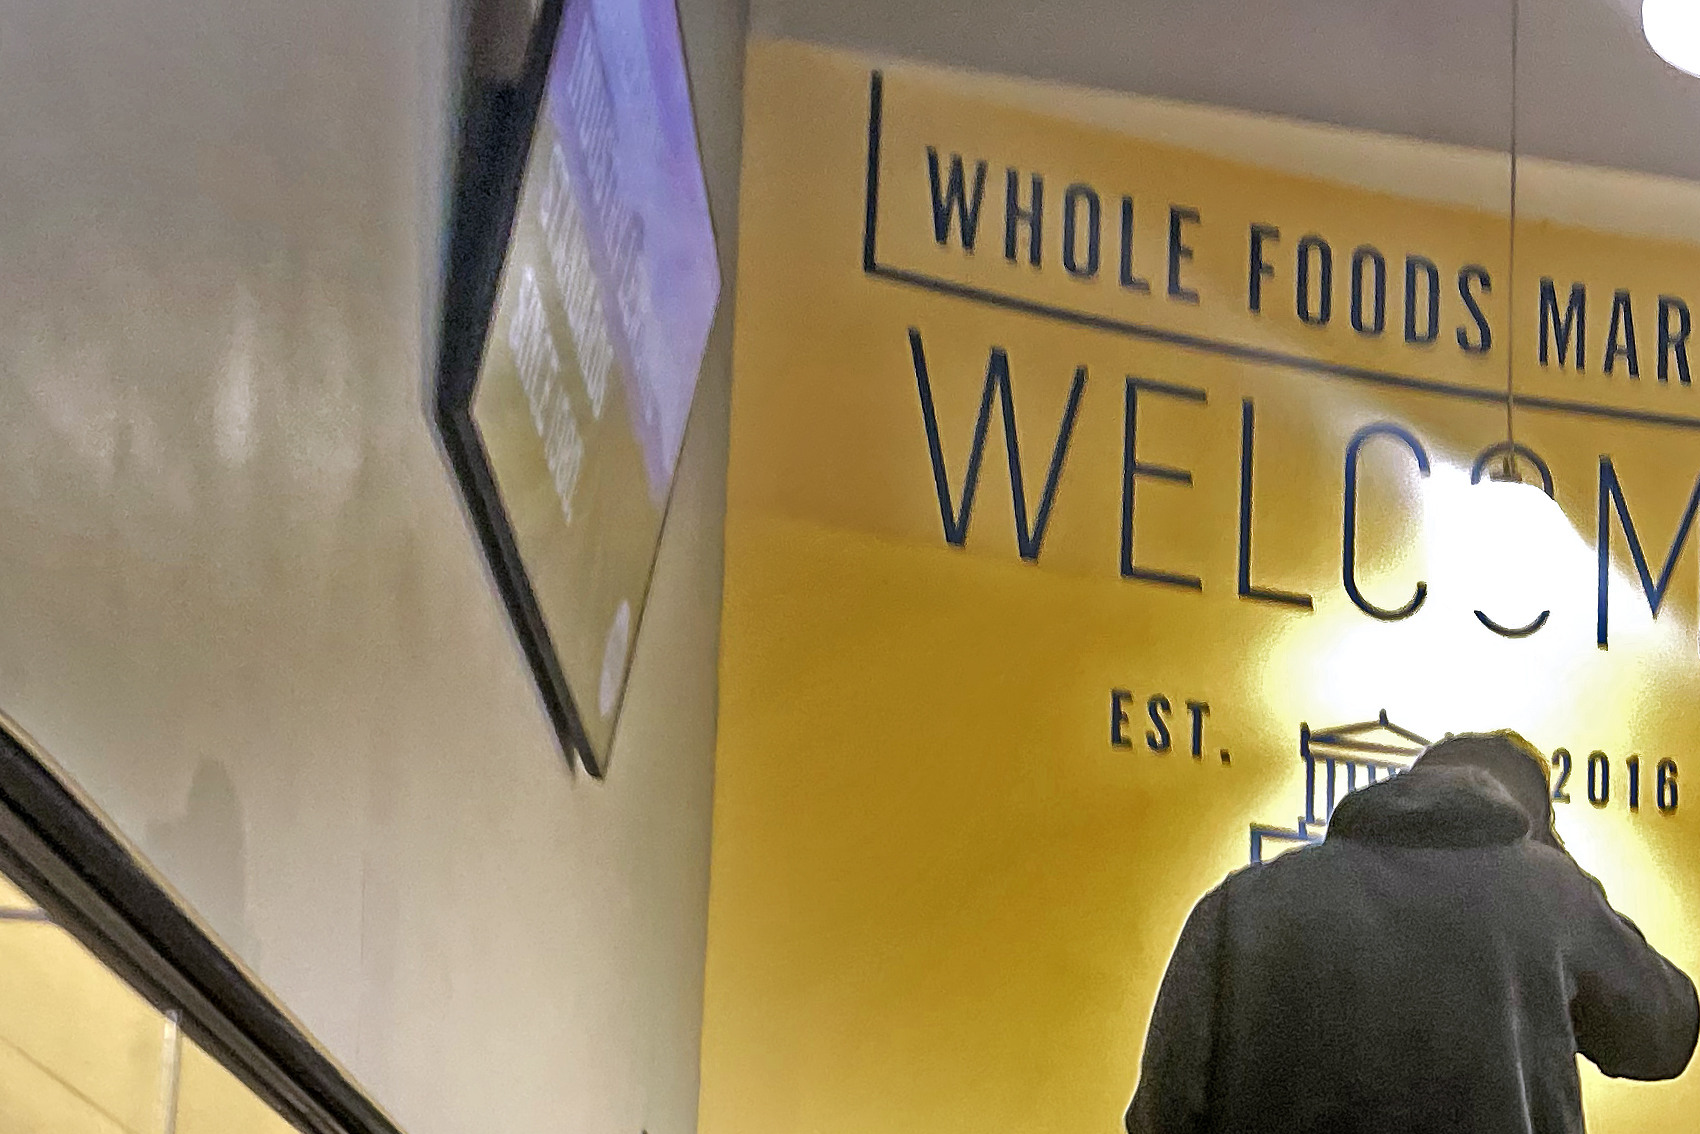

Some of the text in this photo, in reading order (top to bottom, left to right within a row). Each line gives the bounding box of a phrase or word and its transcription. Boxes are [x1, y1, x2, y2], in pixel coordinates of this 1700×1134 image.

[926, 143, 1201, 302] WHOLE
[1248, 223, 1493, 355] FOODS
[1109, 688, 1680, 816] EST. 2016
